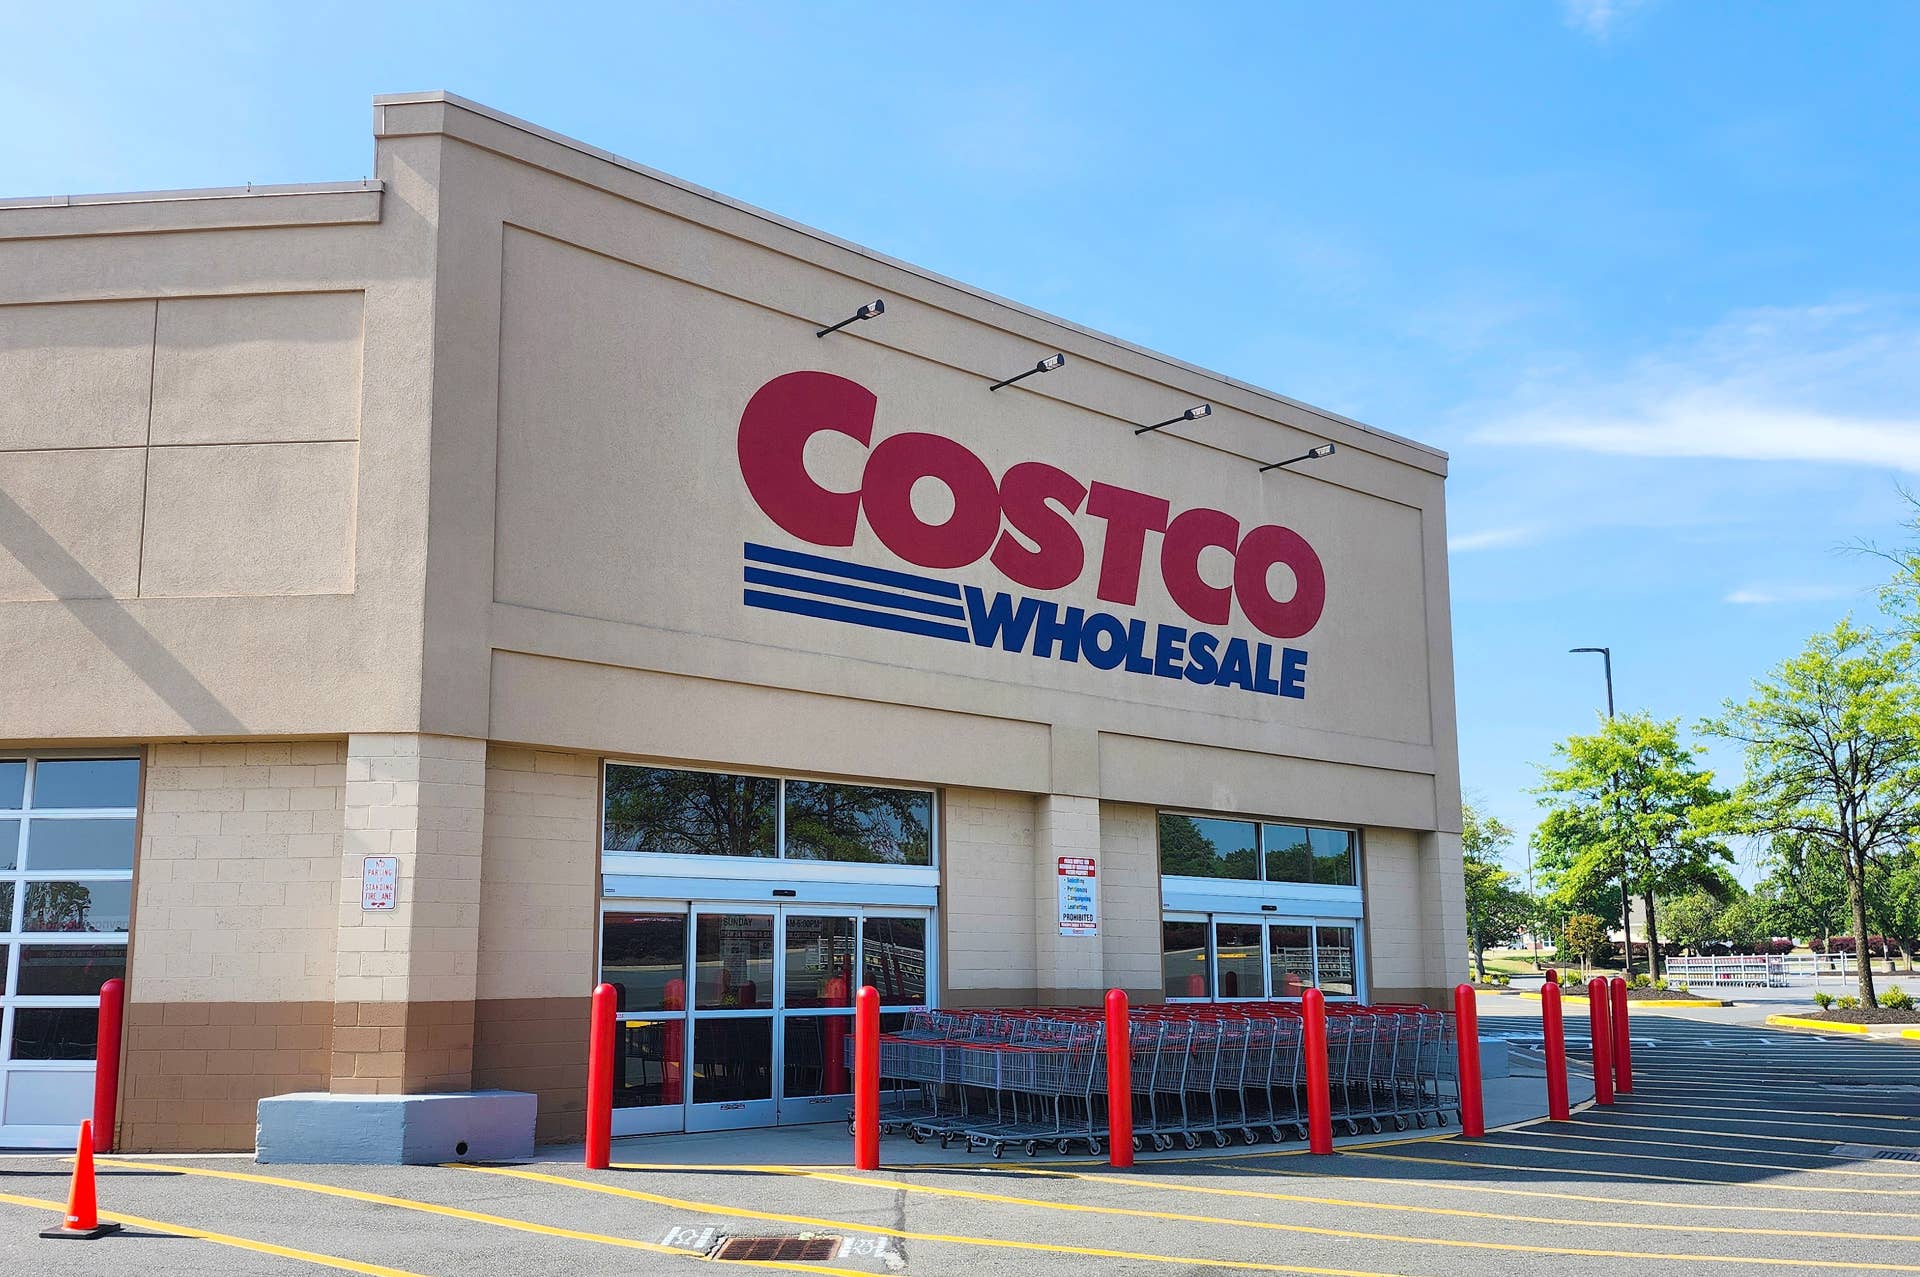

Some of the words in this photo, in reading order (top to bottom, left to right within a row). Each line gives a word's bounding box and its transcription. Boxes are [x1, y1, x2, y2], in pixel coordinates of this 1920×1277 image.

[737, 370, 1325, 638] COSTCO
[963, 585, 1308, 699] WHOLESALE
[378, 892, 393, 900] ANE
[723, 917, 753, 927] SUNDAY
[1063, 913, 1093, 922] PROHIBITED
